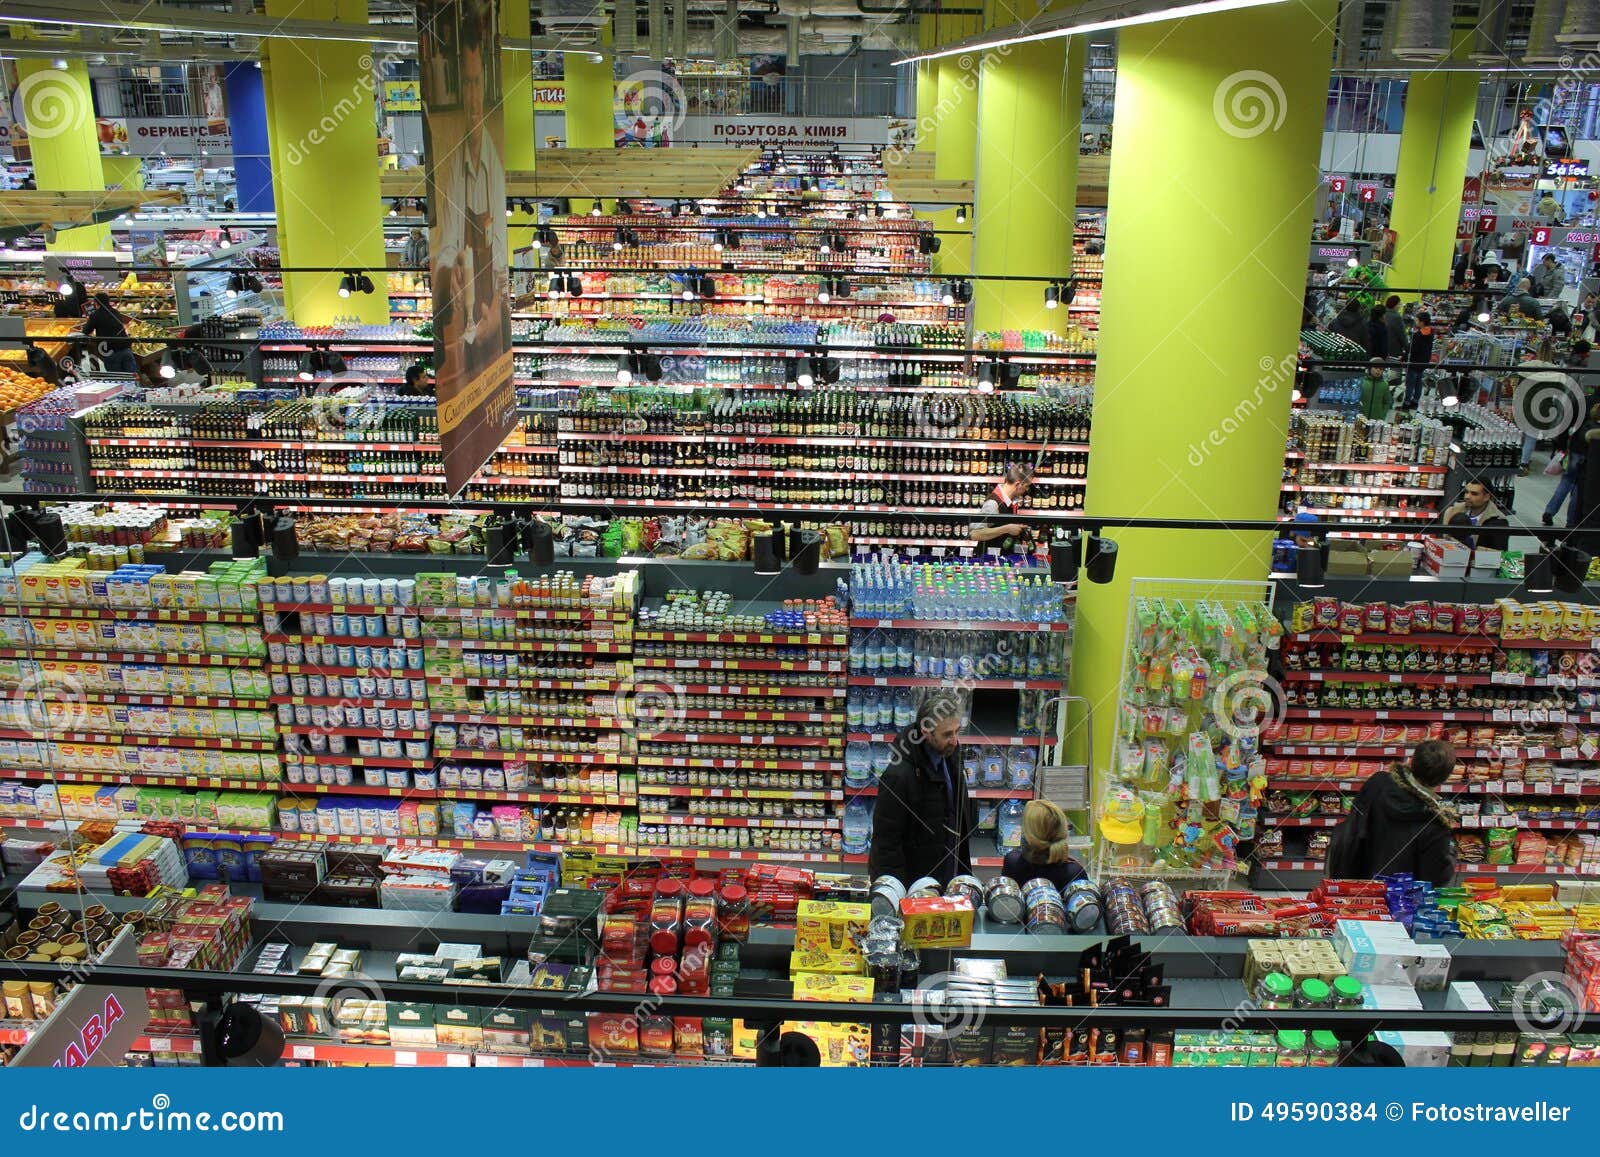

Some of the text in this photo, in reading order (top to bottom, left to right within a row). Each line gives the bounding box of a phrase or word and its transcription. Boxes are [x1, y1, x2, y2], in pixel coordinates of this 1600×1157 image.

[137, 126, 232, 137] ФЕРМЕРС
[713, 124, 847, 137] ПОБУТОВА ХІМІЯ
[1334, 181, 1342, 191] 3
[1364, 190, 1372, 200] 4
[1484, 219, 1492, 229] 7
[1535, 231, 1545, 243] 8
[53, 993, 125, 1067] АВА
